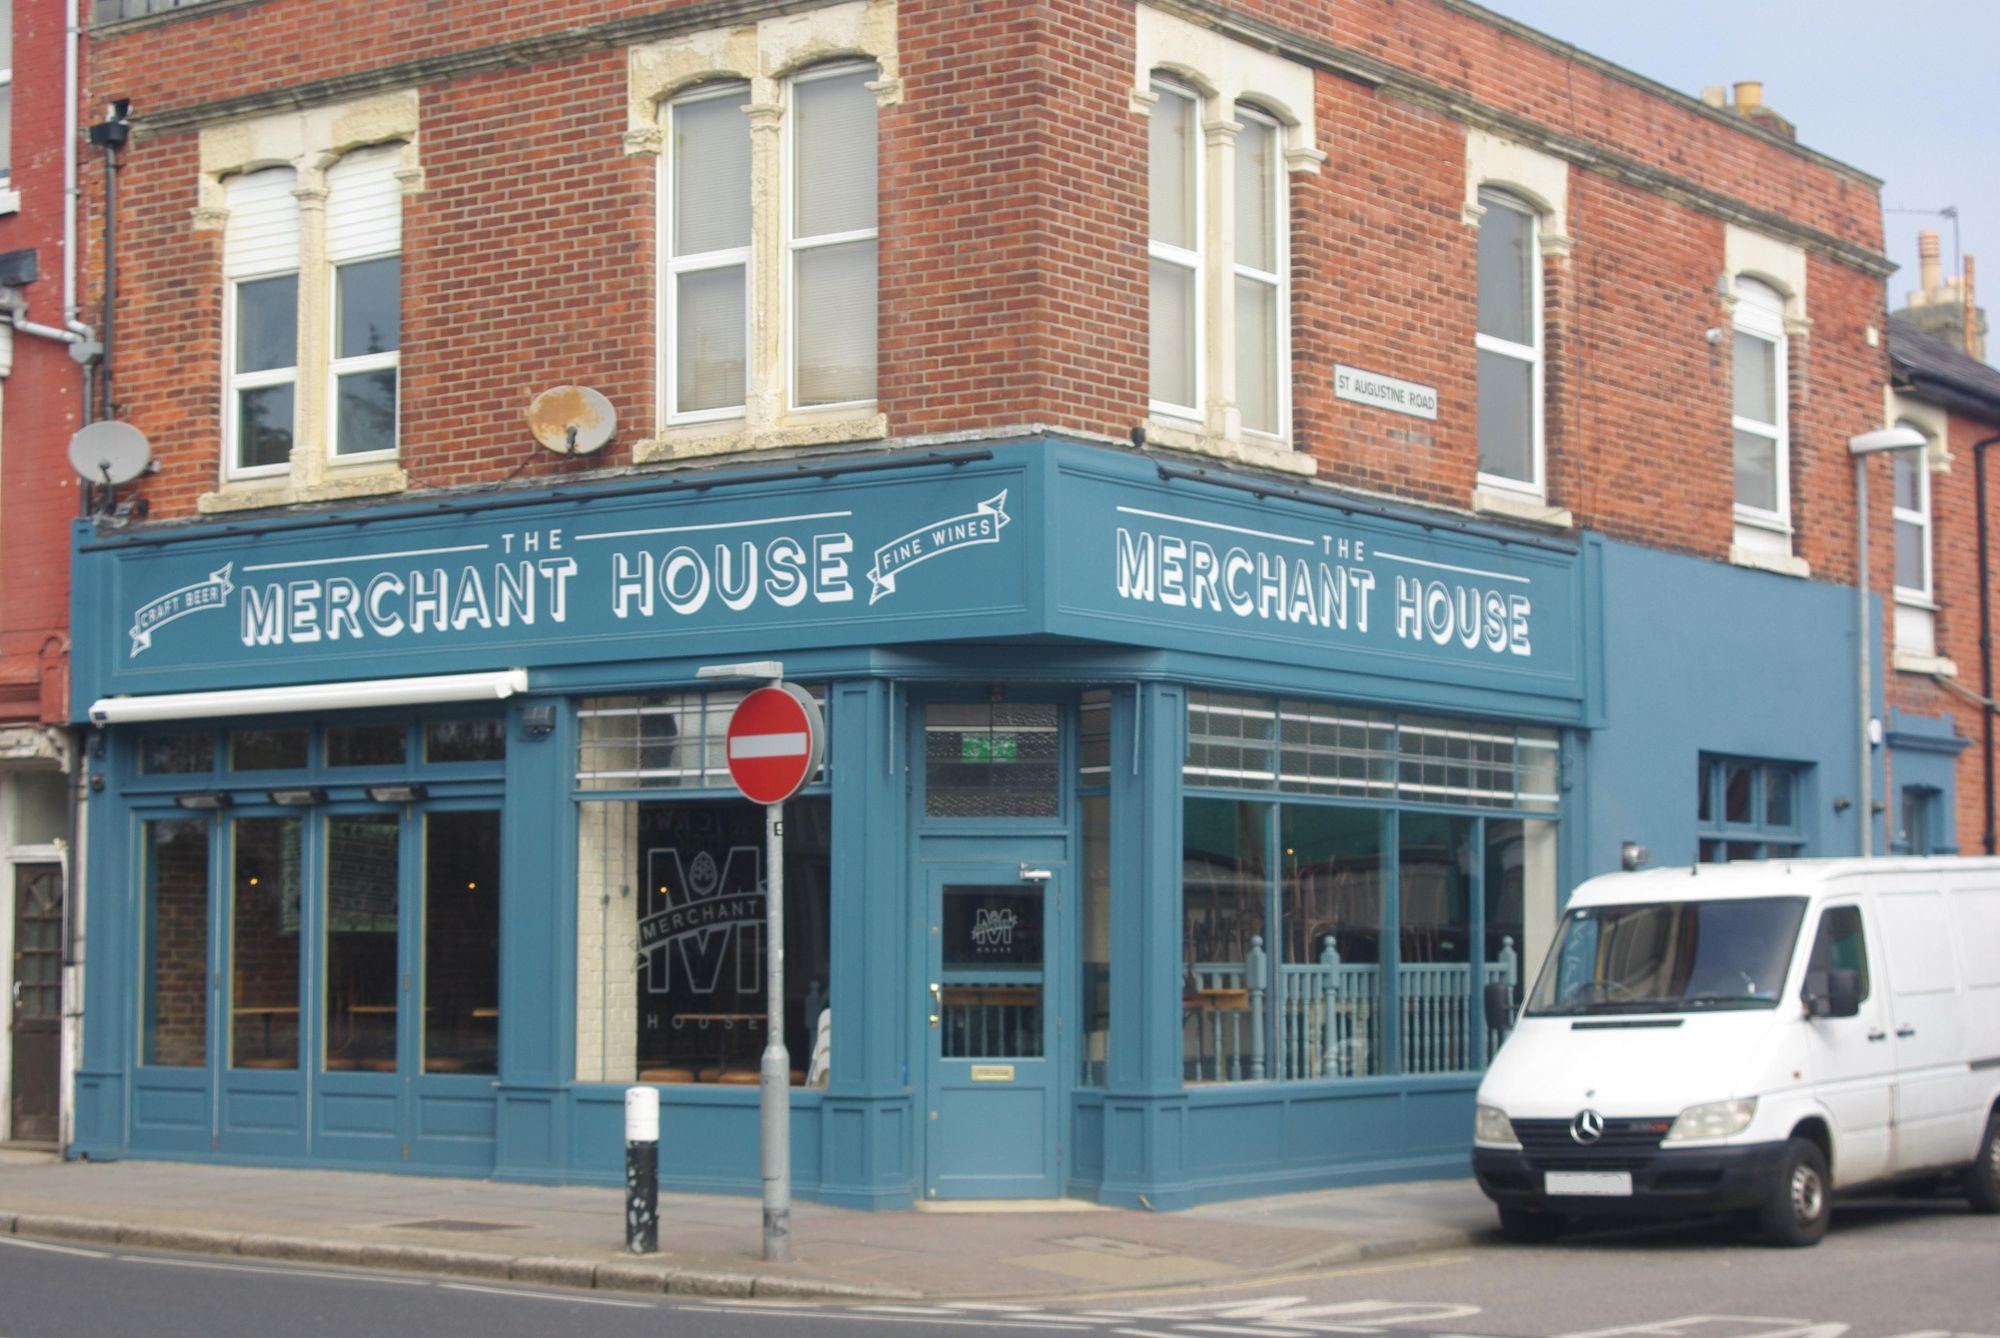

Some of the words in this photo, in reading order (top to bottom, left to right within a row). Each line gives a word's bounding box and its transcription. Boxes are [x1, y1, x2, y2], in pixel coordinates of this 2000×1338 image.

[1338, 375, 1350, 390] ST
[1354, 379, 1406, 404] AUGUSTINE
[1409, 391, 1436, 410] ROAD
[501, 529, 562, 554] THE
[882, 538, 923, 570] FINE
[932, 519, 991, 546] WINES
[1322, 535, 1365, 562] THE
[140, 596, 179, 627] CRAFT
[184, 586, 219, 607] BEER
[240, 556, 578, 646] MERCHANT
[612, 532, 854, 618] HOUSE
[1116, 527, 1376, 633] MERCHANT
[1395, 575, 1532, 656] HOUSE
[642, 900, 758, 940] MERCHANT
[646, 1013, 759, 1030] HOUSE
